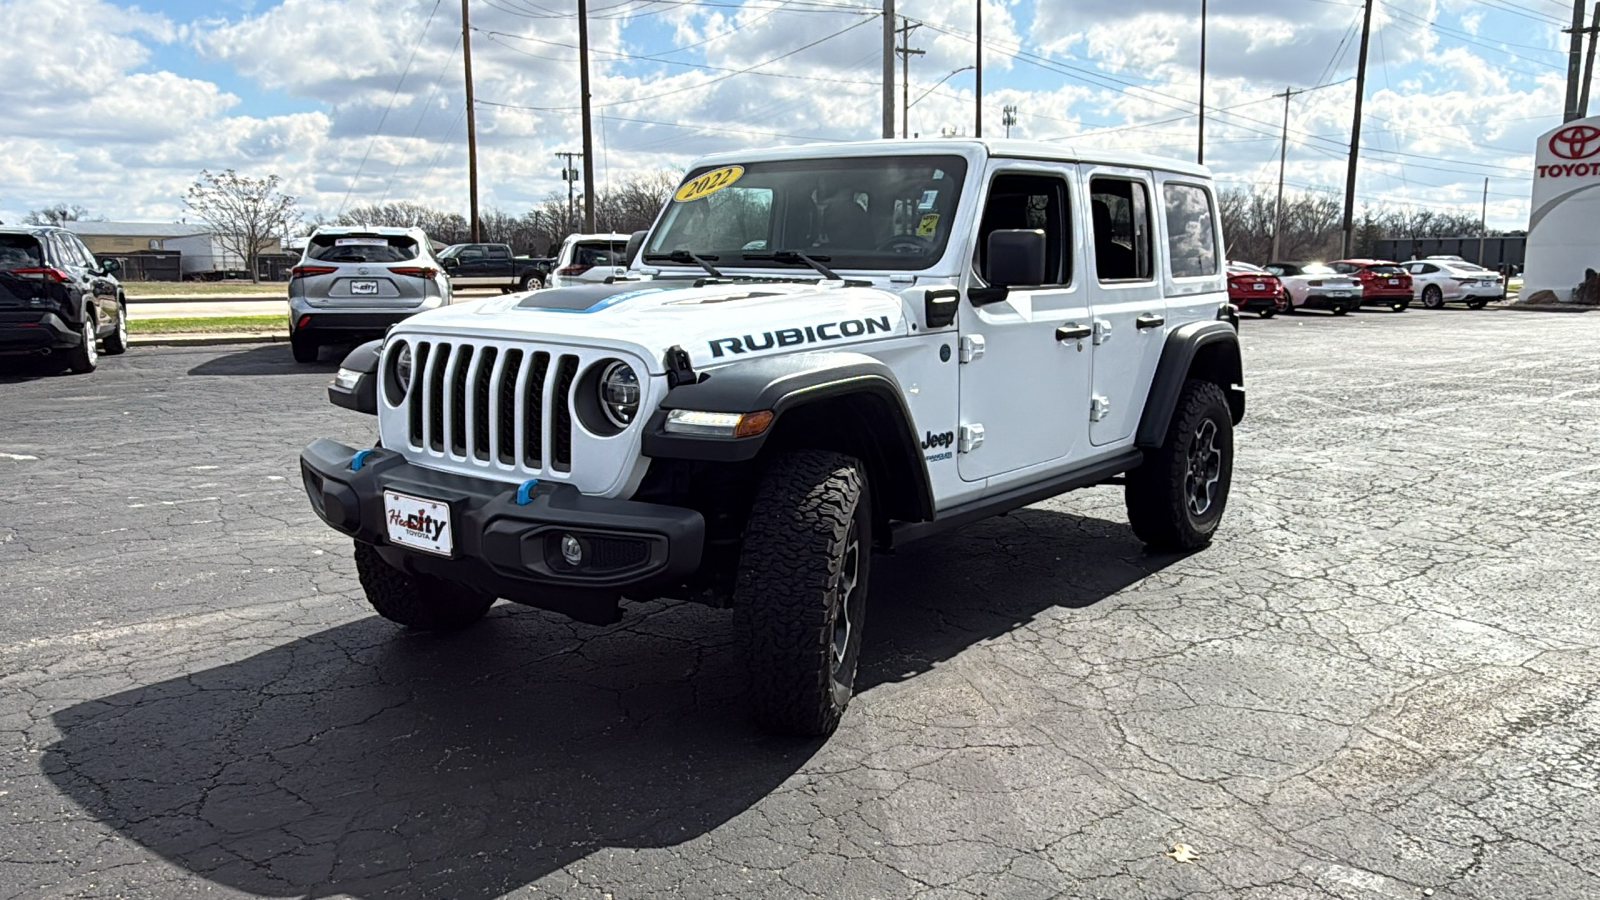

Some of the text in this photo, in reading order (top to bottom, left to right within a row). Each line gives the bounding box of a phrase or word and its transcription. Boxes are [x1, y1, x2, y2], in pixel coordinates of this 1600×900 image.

[1537, 162, 1600, 178] TOYOT
[684, 169, 732, 198] 2022
[708, 316, 892, 359] RUBICON
[921, 430, 954, 450] Jeep
[406, 529, 430, 540] TOYOTA
